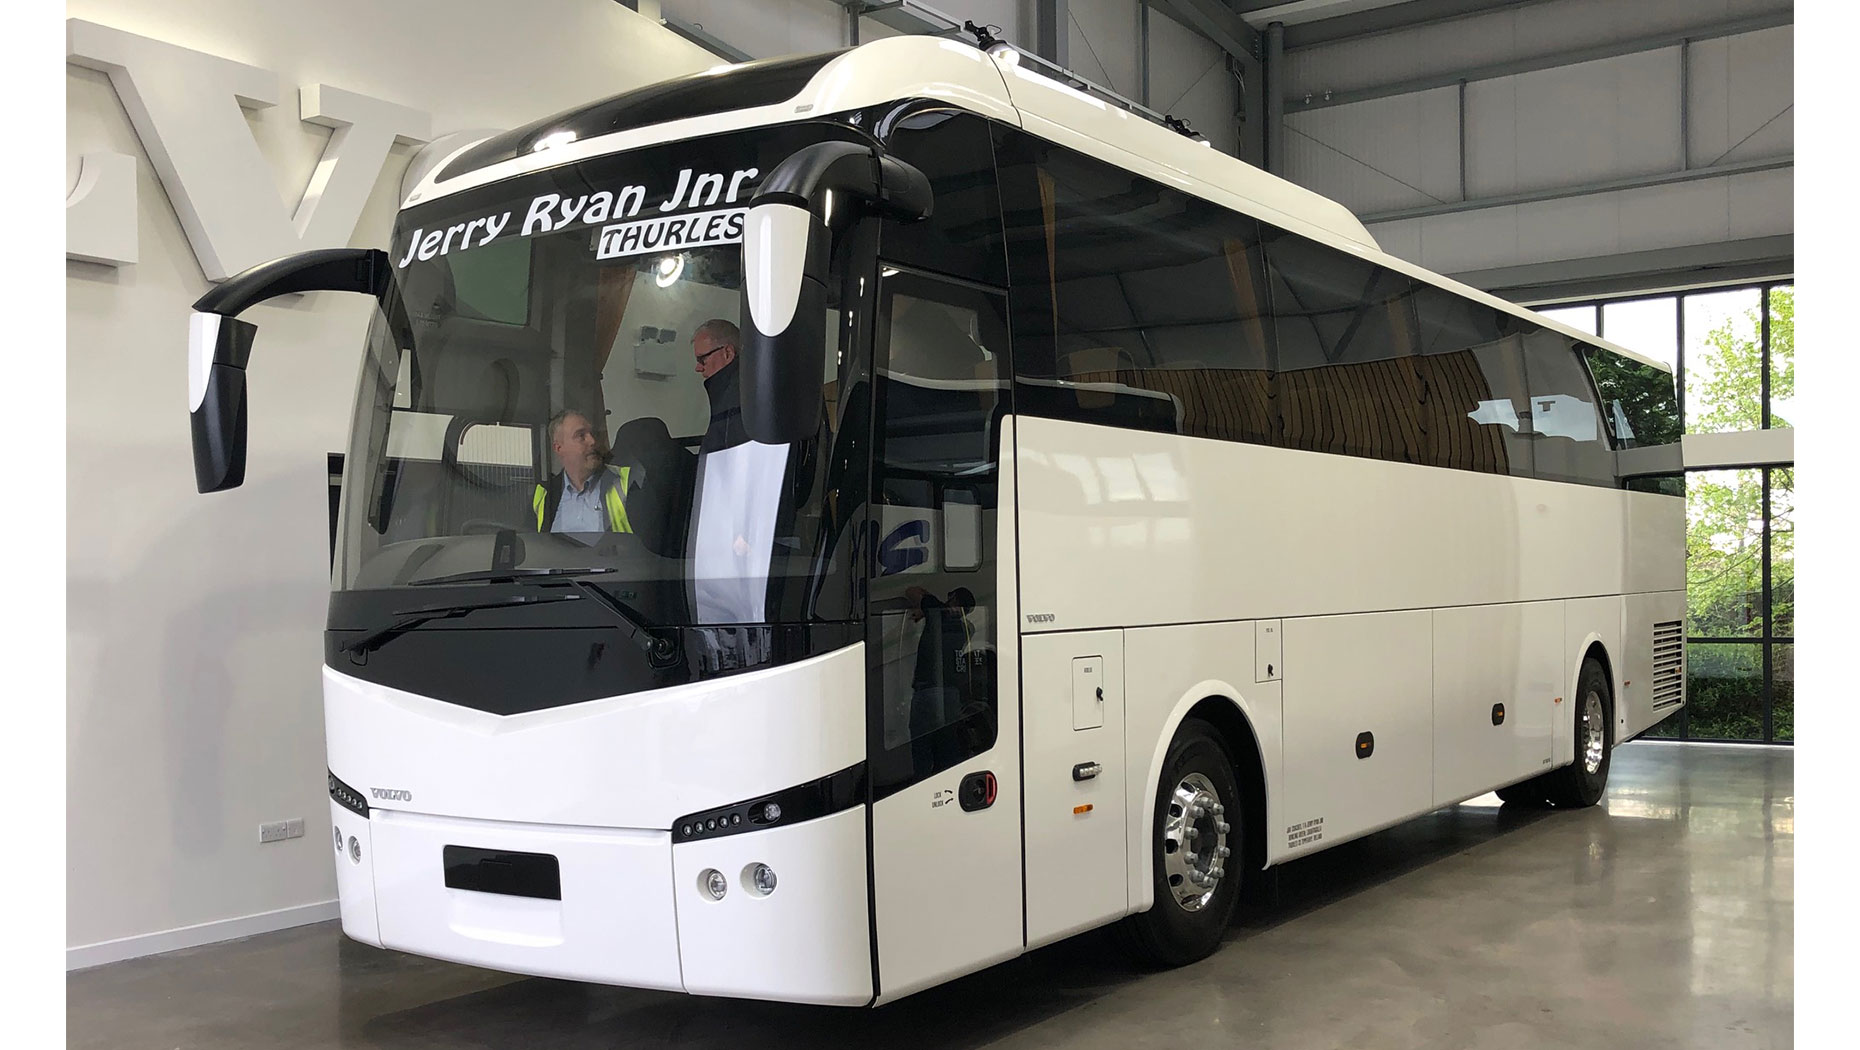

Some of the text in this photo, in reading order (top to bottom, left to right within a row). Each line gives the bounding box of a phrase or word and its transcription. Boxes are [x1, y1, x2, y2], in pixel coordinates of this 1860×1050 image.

[398, 167, 759, 269] Jerry Ryan Jnr
[601, 212, 745, 256] THURLES
[369, 787, 413, 802] VOLVO
